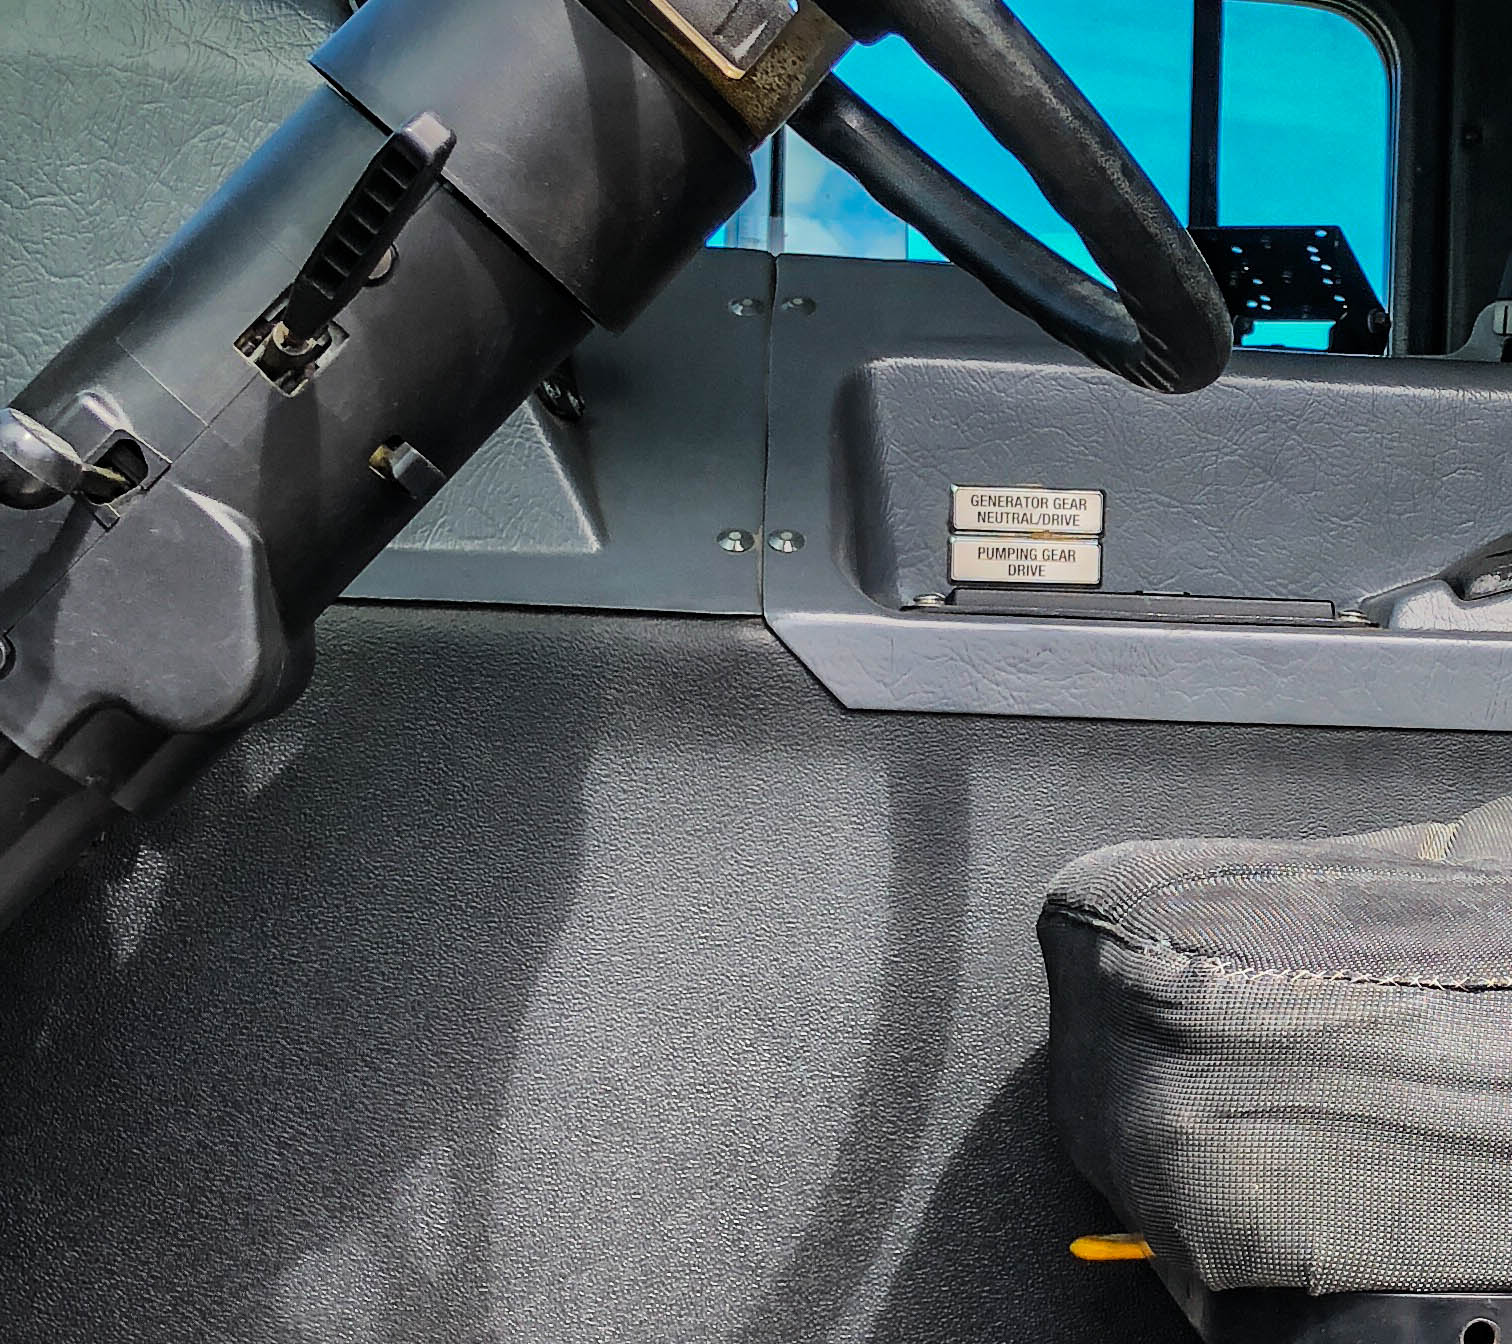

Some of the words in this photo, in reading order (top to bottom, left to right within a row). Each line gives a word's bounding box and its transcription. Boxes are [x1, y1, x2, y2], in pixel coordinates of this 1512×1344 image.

[971, 494, 1049, 509] GENERATOR
[1053, 497, 1087, 511] GEAR
[977, 511, 1080, 527] NEUTRAL/DRIVE
[977, 546, 1038, 561] PUMPING
[1042, 549, 1076, 562] GEAR
[1008, 564, 1046, 577] DRIVE
